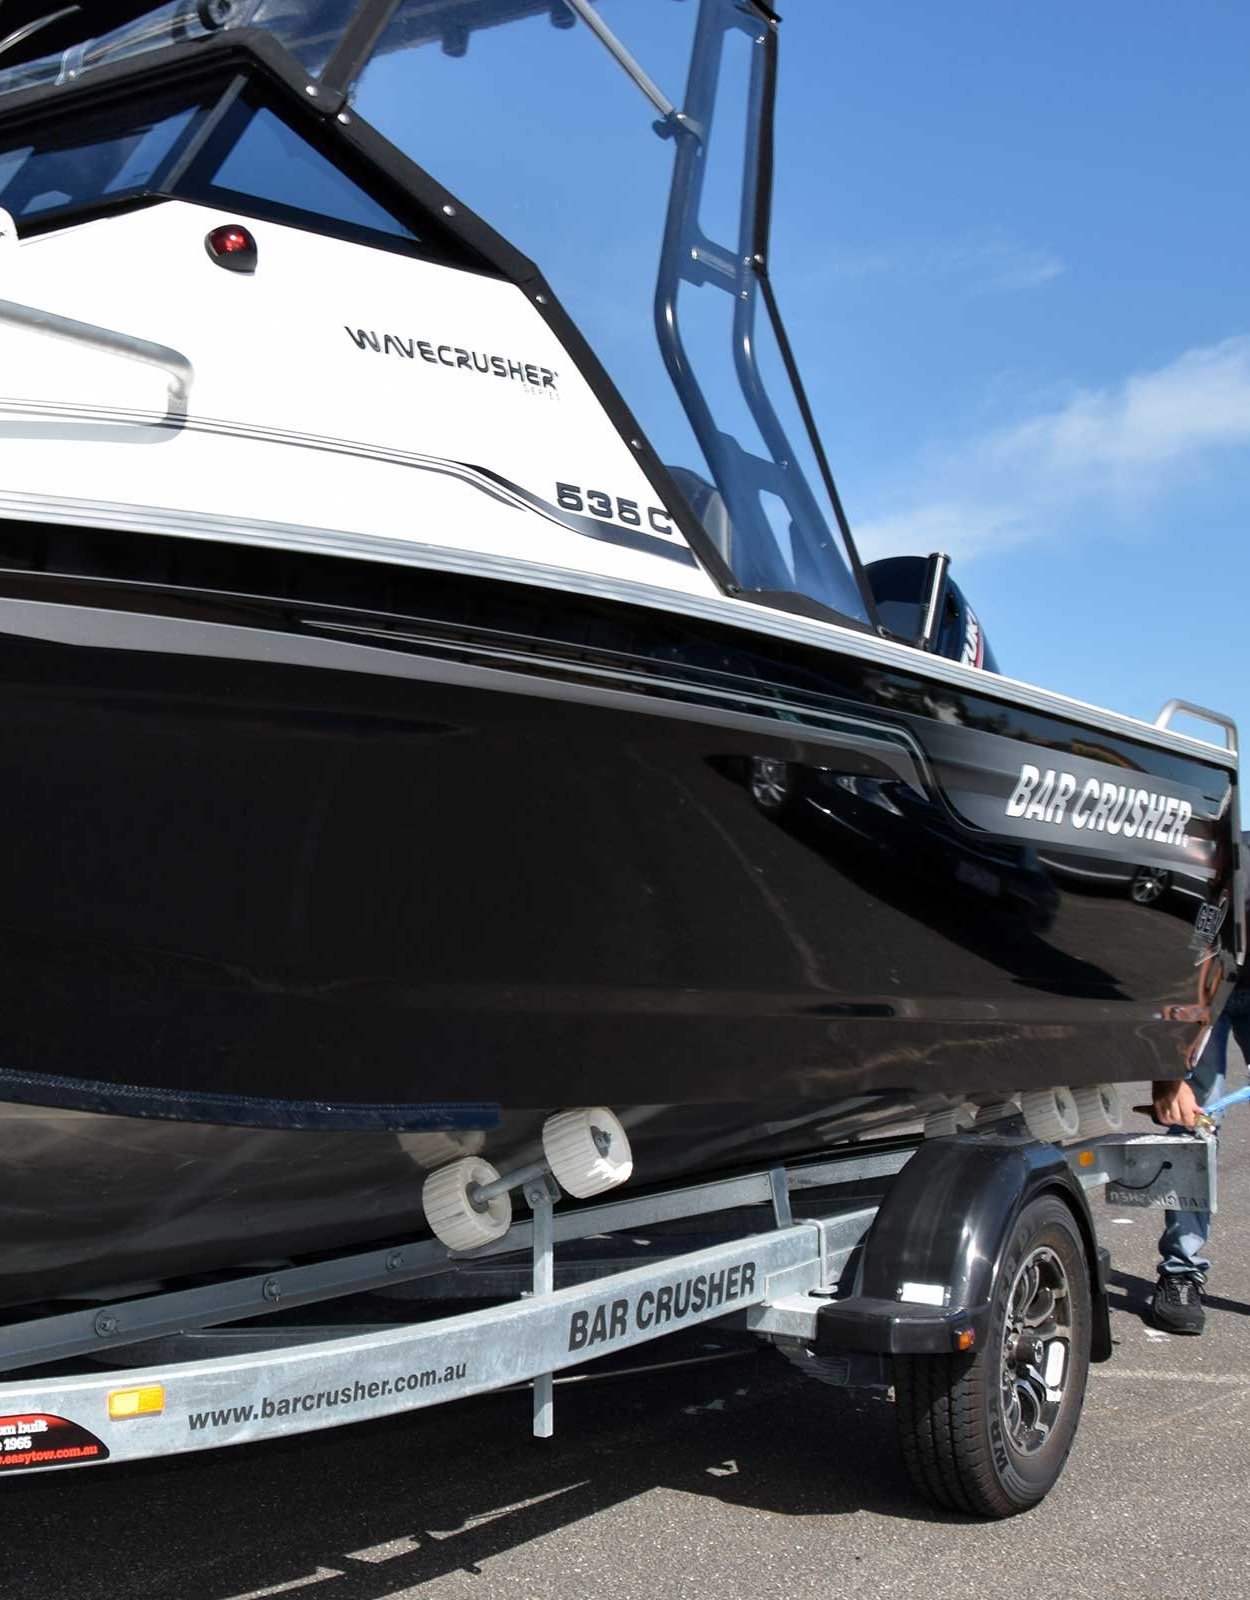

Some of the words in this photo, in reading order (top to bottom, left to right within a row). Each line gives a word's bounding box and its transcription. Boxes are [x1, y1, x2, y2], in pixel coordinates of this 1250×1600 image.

[344, 325, 557, 391] WAVECRUSHER
[1005, 764, 1076, 824] BAR
[1072, 778, 1192, 847] CRUSHER
[568, 1310, 627, 1351] BAR
[636, 1261, 756, 1330] CRUSHER
[17, 1419, 49, 1435] built
[188, 1360, 467, 1431] www.barcrusher.com.au
[3, 1435, 32, 1451] 1965
